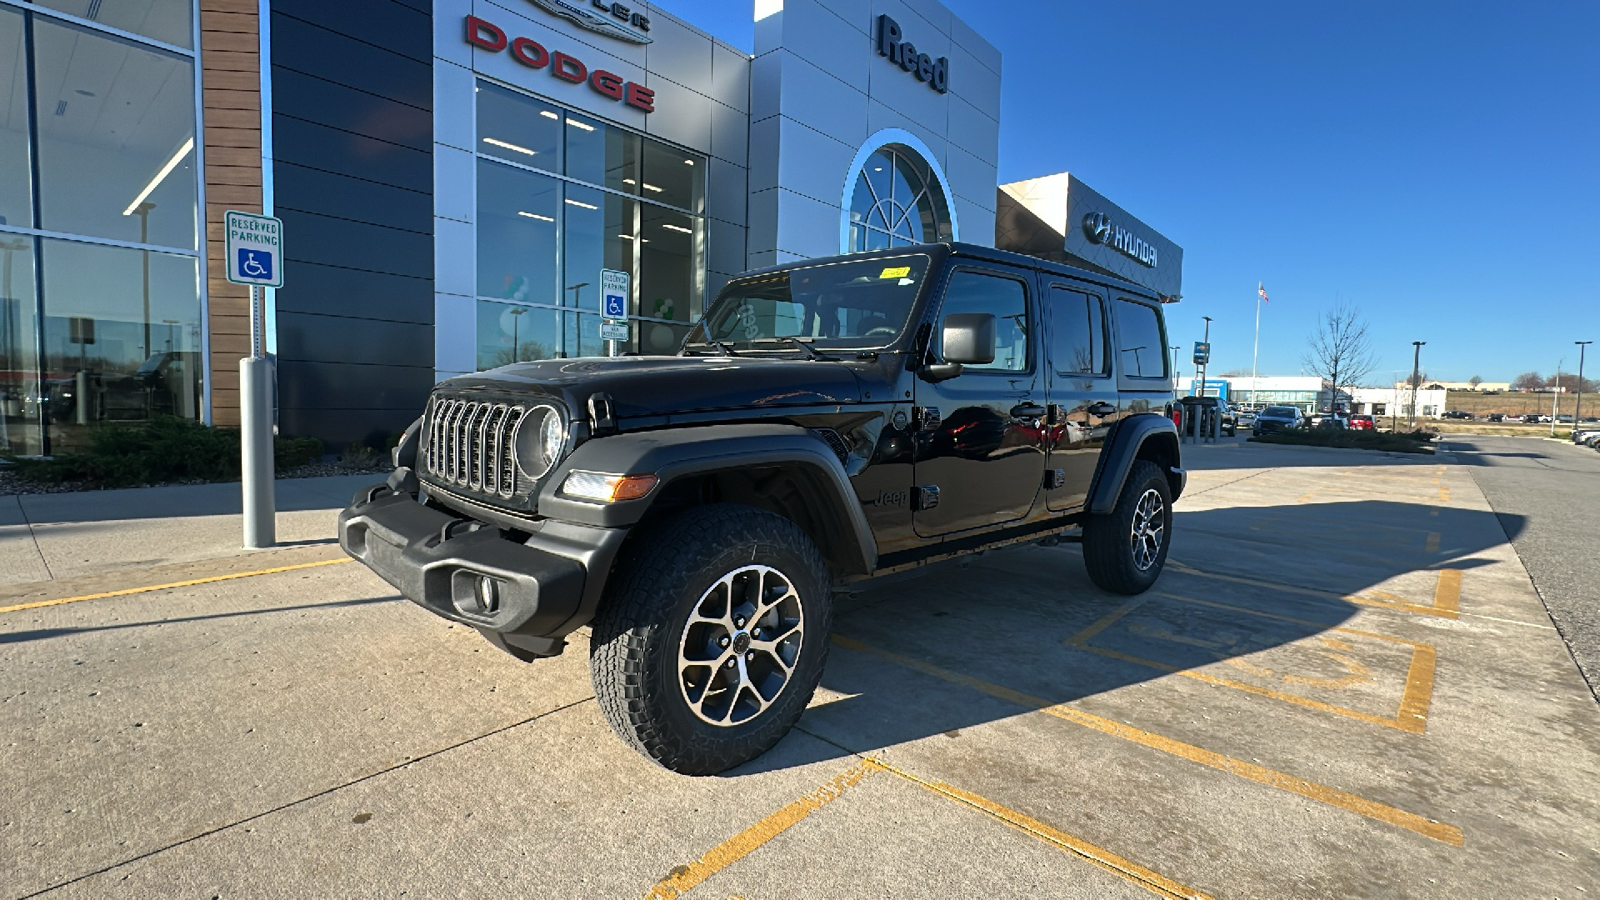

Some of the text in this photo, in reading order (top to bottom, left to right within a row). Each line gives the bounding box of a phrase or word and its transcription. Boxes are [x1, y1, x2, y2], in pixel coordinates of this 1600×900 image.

[878, 14, 949, 95] Reed
[465, 14, 655, 113] DODGE
[231, 218, 276, 233] RESERVED
[231, 230, 277, 246] PARKING
[1114, 225, 1158, 267] HYUNDAI
[603, 283, 626, 292] PARKING
[874, 490, 906, 507] Jeep
